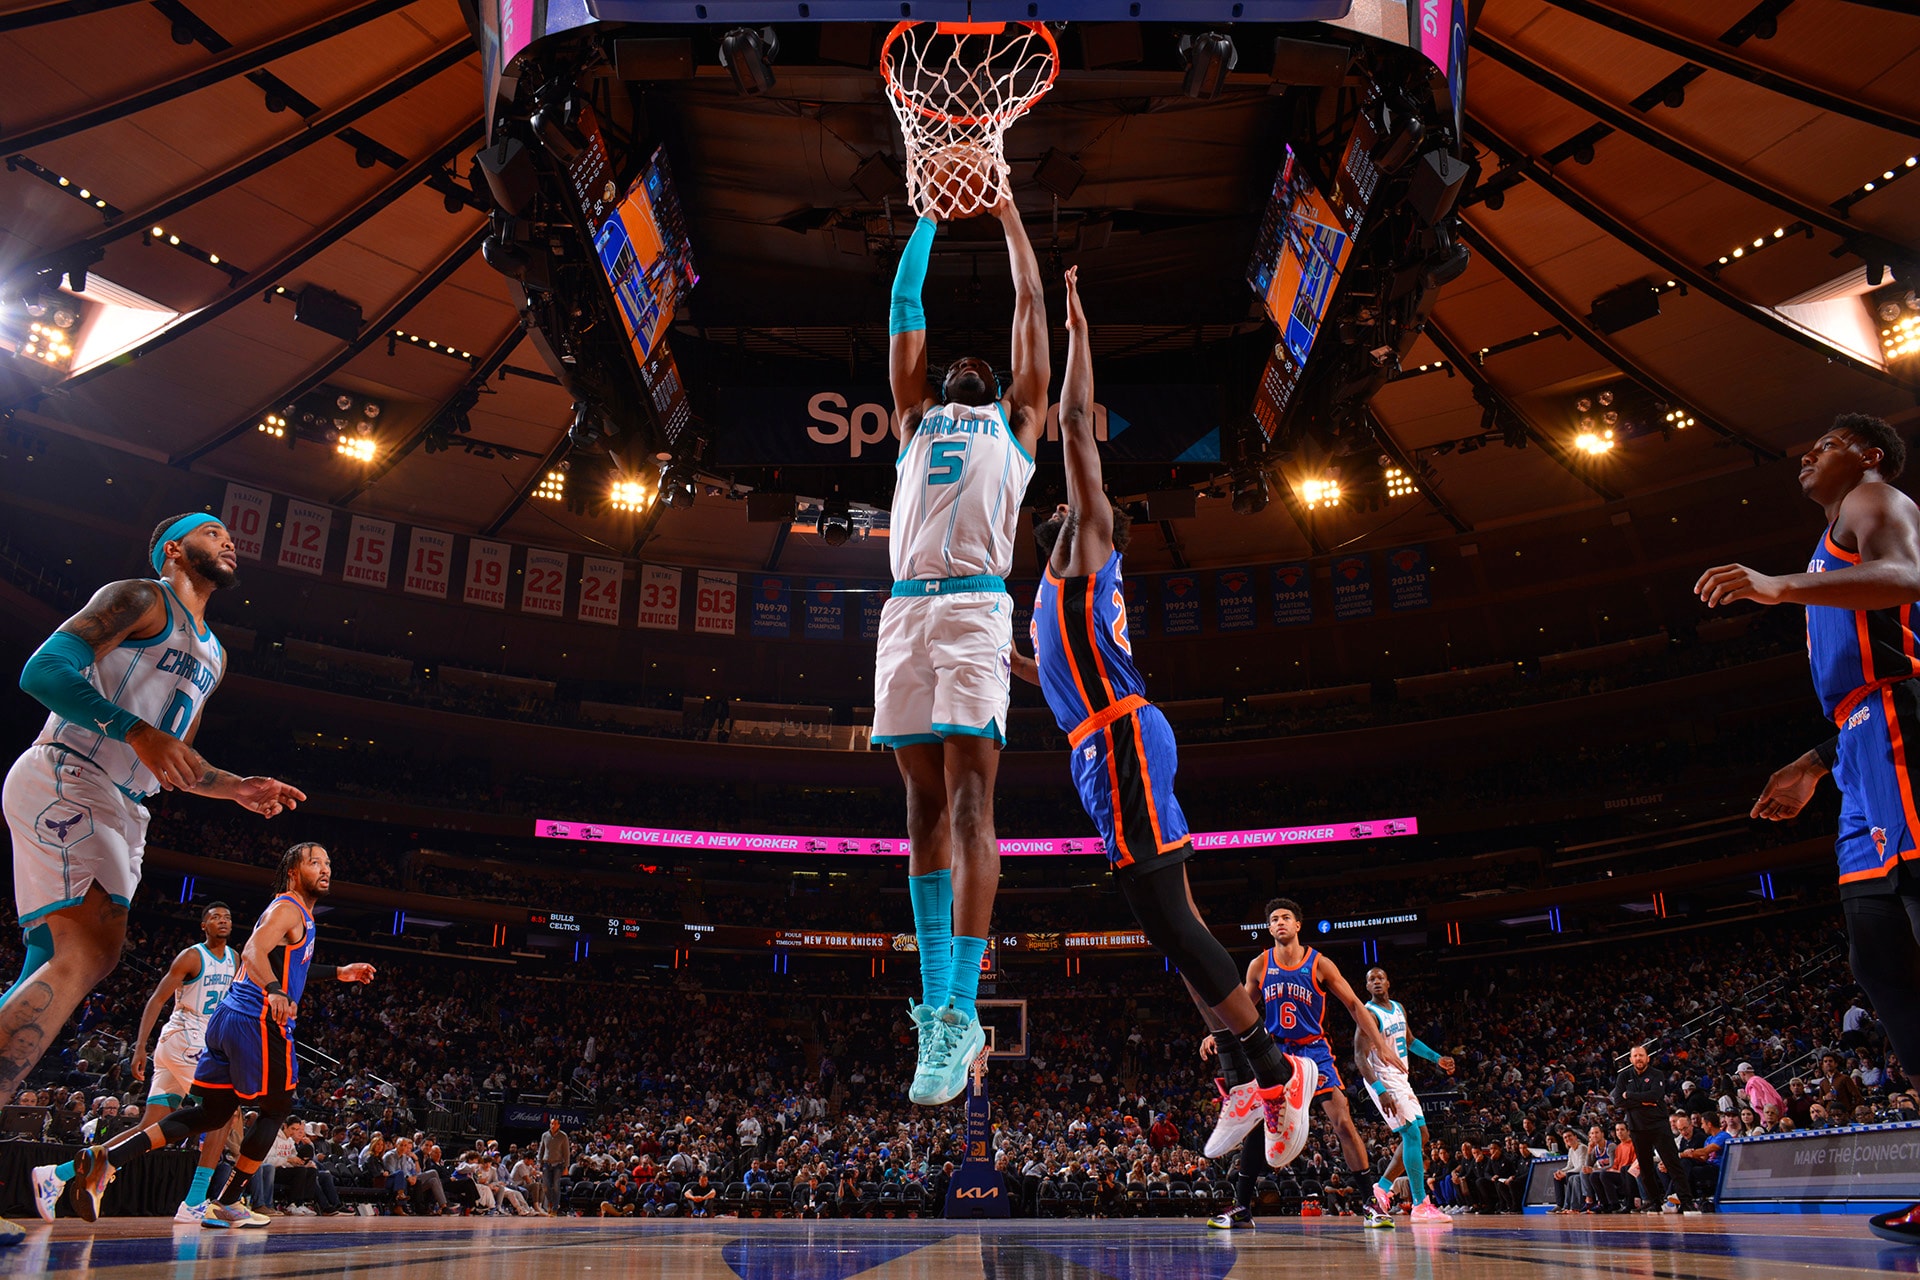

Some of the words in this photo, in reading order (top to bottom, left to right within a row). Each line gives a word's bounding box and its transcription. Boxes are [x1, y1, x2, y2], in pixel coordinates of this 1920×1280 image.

[594, 198, 604, 216] 56
[1345, 202, 1354, 220] 46
[920, 416, 999, 440] HARLOTTE
[928, 442, 966, 485] 5
[228, 505, 260, 535] 10
[289, 521, 321, 552] 12
[231, 537, 260, 554] ICKS
[353, 536, 385, 565] 15
[281, 550, 322, 569] KNICKS
[414, 548, 444, 576] 15
[346, 565, 386, 582] KNICKS
[473, 559, 502, 586] 19
[1392, 574, 1426, 586] 2012-13
[407, 576, 446, 594] KNICKS
[527, 568, 563, 595] 22
[584, 576, 617, 604] 24
[1336, 583, 1370, 595] 1998-99
[466, 587, 504, 604] KNICKS
[524, 596, 562, 611] KNICKS
[643, 584, 677, 609] 33
[698, 588, 735, 614] 613
[1220, 596, 1253, 606] 1993-94
[581, 604, 617, 620] KNICKS
[755, 603, 788, 613] 1969-70
[809, 606, 841, 615] 1972-73
[1165, 601, 1199, 611] 1992-93
[640, 612, 676, 625] KNICKS
[697, 616, 733, 630] KNICKS
[160, 689, 193, 740] 0
[1604, 798, 1628, 809] BUD
[1630, 792, 1664, 806] LIGHT
[619, 830, 659, 843] MOVE
[662, 833, 692, 845] LIKE
[695, 835, 705, 845] A
[708, 836, 741, 847] NEW
[744, 837, 798, 849] YORKER
[1198, 836, 1227, 846] LIKE
[1230, 836, 1240, 845] A
[1244, 833, 1278, 844] NEW
[1280, 828, 1334, 841] YORKER
[1000, 842, 1053, 853] MOVING
[549, 922, 581, 931] CELTICS
[550, 914, 574, 922] BULLS
[608, 919, 619, 927] 50
[608, 928, 618, 936] 71
[694, 933, 701, 941] 9
[1064, 936, 1108, 946] CHARLOTTE
[1110, 935, 1145, 945] HORNETS
[1251, 932, 1258, 940] 9
[804, 936, 822, 945] NEW
[825, 937, 848, 946] YORK
[851, 937, 883, 946] KNICKS
[1002, 936, 1017, 946] 46
[1264, 982, 1284, 1003] NEW
[1286, 982, 1313, 1006] YORK
[1280, 1001, 1297, 1029] 6
